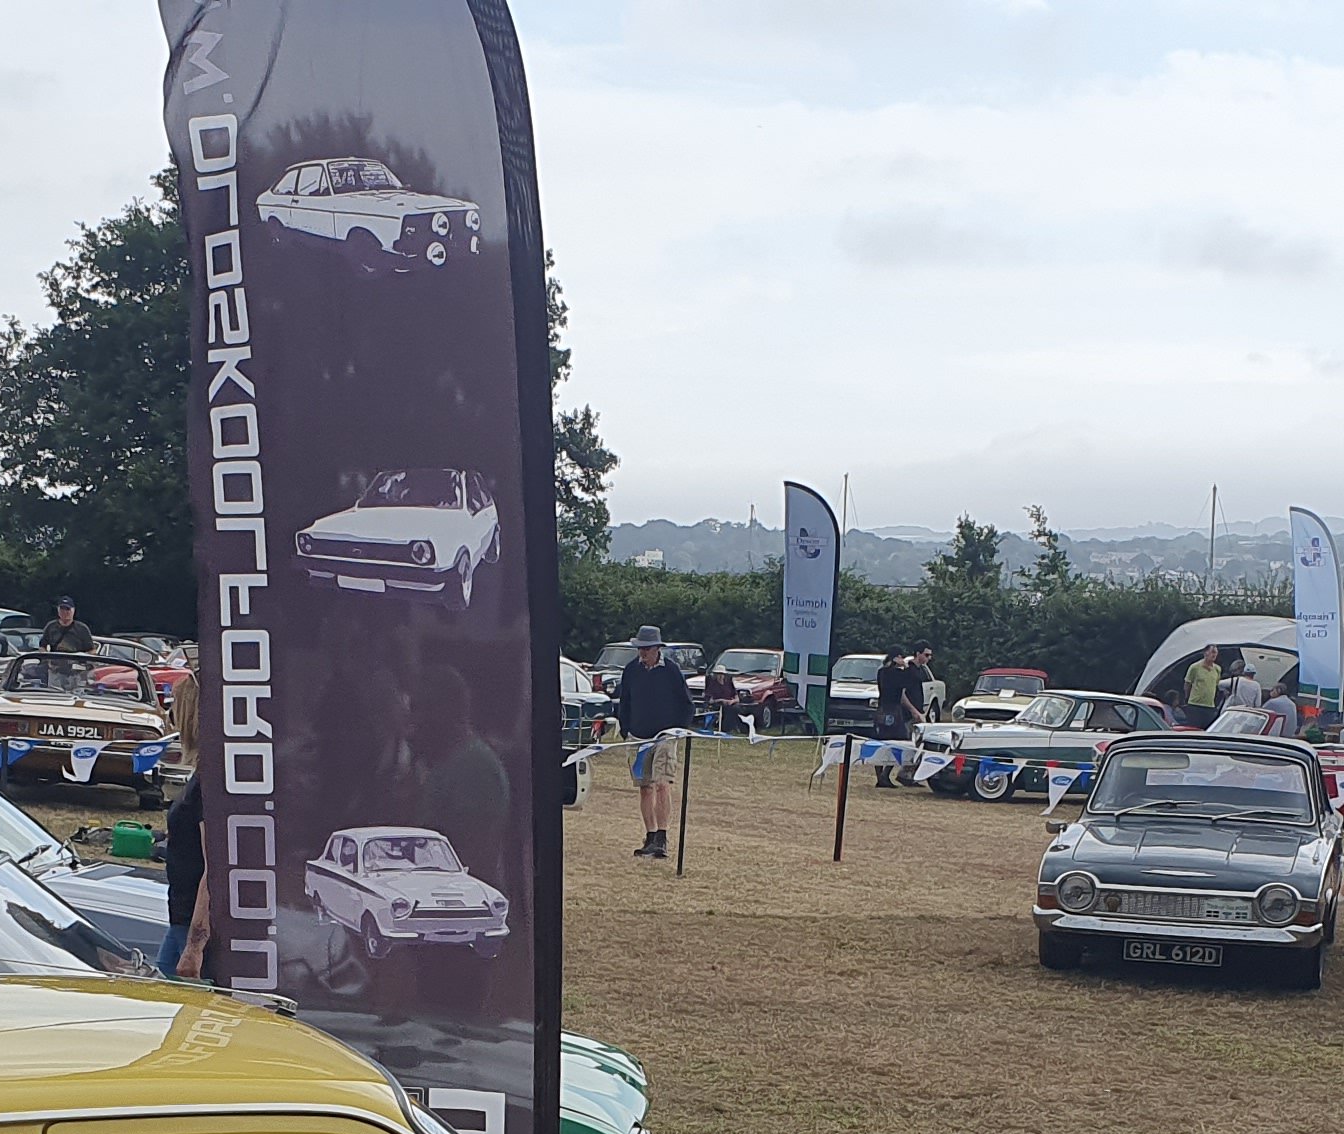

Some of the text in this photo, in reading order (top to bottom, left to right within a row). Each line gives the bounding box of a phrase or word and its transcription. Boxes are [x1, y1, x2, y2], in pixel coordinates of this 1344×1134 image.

[786, 596, 827, 609] Triumph
[794, 618, 817, 629] Club
[38, 723, 103, 739] JAA 992L
[1129, 942, 1217, 964] GRL 612D
